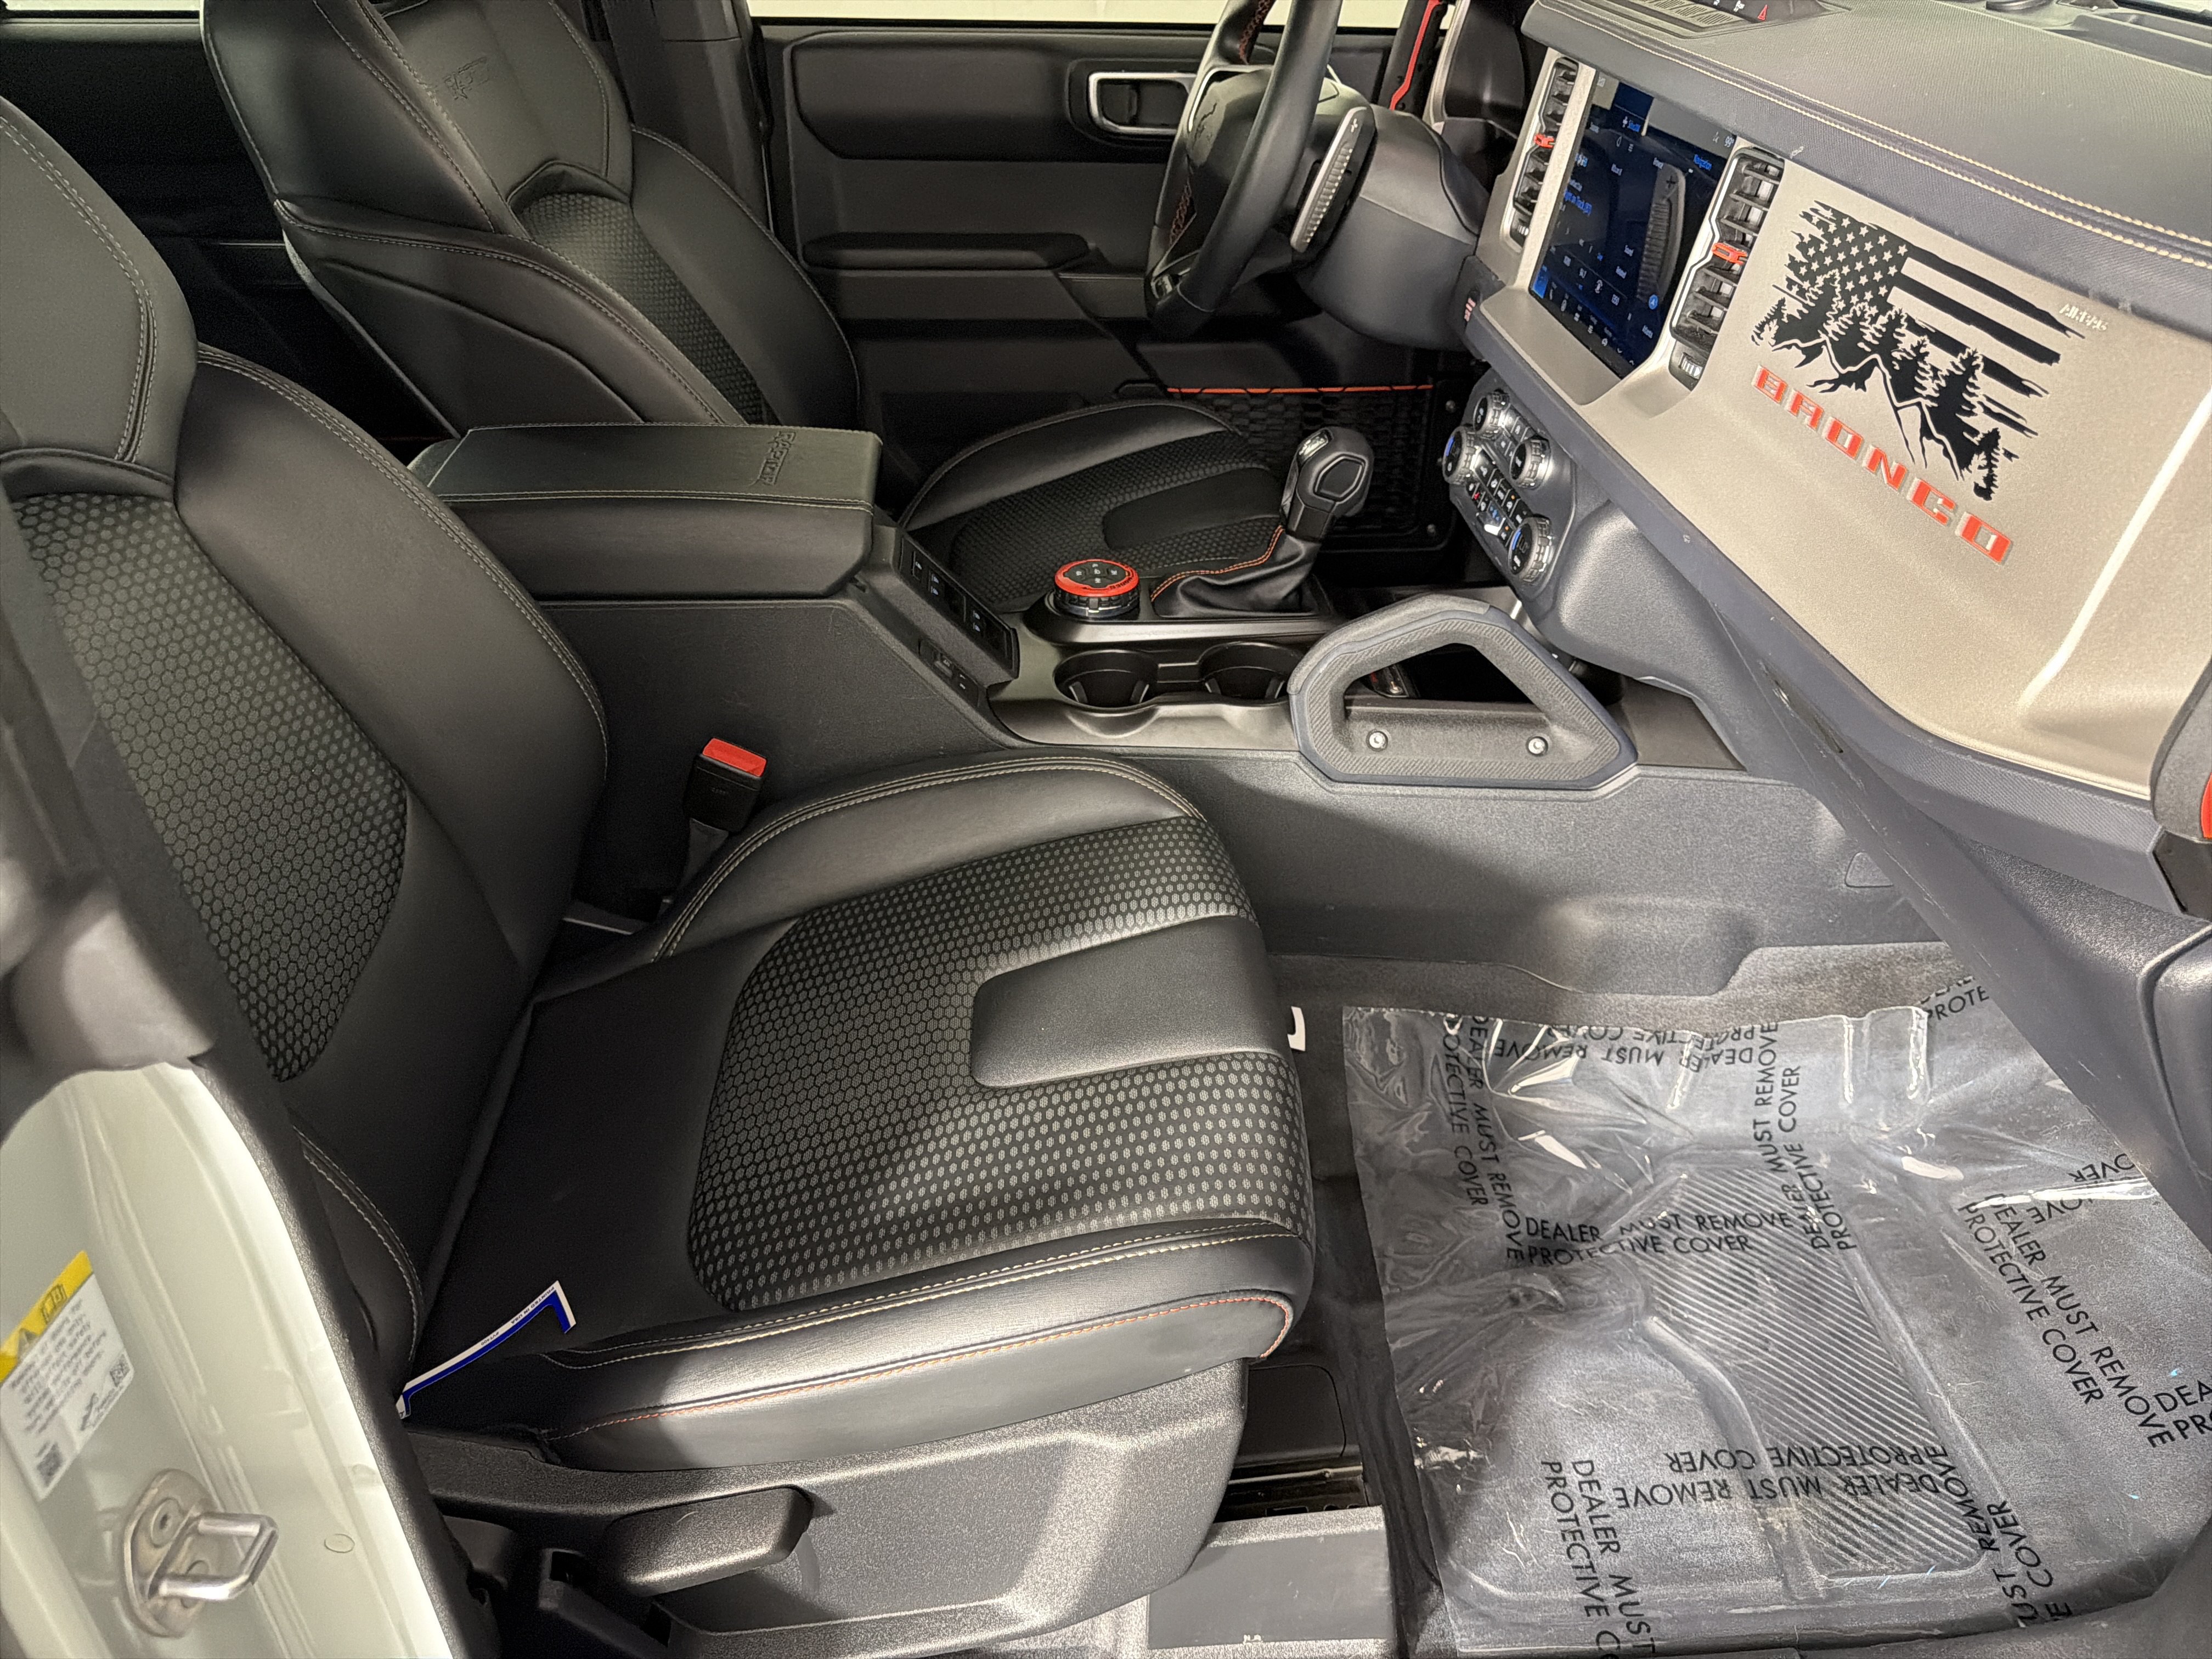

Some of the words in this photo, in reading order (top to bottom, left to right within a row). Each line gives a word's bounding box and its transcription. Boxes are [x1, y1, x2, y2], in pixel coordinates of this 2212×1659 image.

[1751, 364, 2013, 565] BRONCO
[1494, 1039, 1587, 1060] REMOVE
[1601, 1046, 1664, 1066] MUST
[1754, 1022, 1778, 1106] REMOVE
[1443, 1032, 1471, 1134] OTECTIVE
[1778, 1065, 1801, 1133] COVER
[1753, 1118, 1788, 1173] MUST
[2068, 1153, 2135, 1183] OVER
[1454, 1146, 1489, 1206] COVER
[1472, 1102, 1500, 1164] MUST
[1487, 1172, 1525, 1261] REMOVE
[1784, 1143, 1857, 1250] PROTECTIVE
[1526, 1217, 1604, 1243] DEALER
[1620, 1212, 1684, 1236] MUST
[1696, 1212, 1794, 1231] REMOVE
[1528, 1235, 1664, 1266] PROTECTIVE
[1673, 1234, 1753, 1255] COVER
[1957, 1201, 2051, 1321] PROTECTIVE
[2042, 1328, 2104, 1405] COVER
[2040, 1274, 2100, 1335] MUST
[2090, 1345, 2176, 1448] REMOVE
[1663, 1449, 1757, 1474] COVER
[1765, 1446, 1926, 1468] PROTECTIVE
[1844, 1472, 1940, 1497] DEALER
[1612, 1478, 1731, 1509] REMOVE
[1750, 1475, 1823, 1500] MUST
[1925, 1445, 2001, 1551] REMOVE
[1540, 1460, 1611, 1618] PROTECTIVE
[1571, 1459, 1621, 1555] DEALER
[1608, 1573, 1656, 1654] MUST
[1987, 1500, 2053, 1588] COVER
[1992, 1568, 2039, 1622] UST
